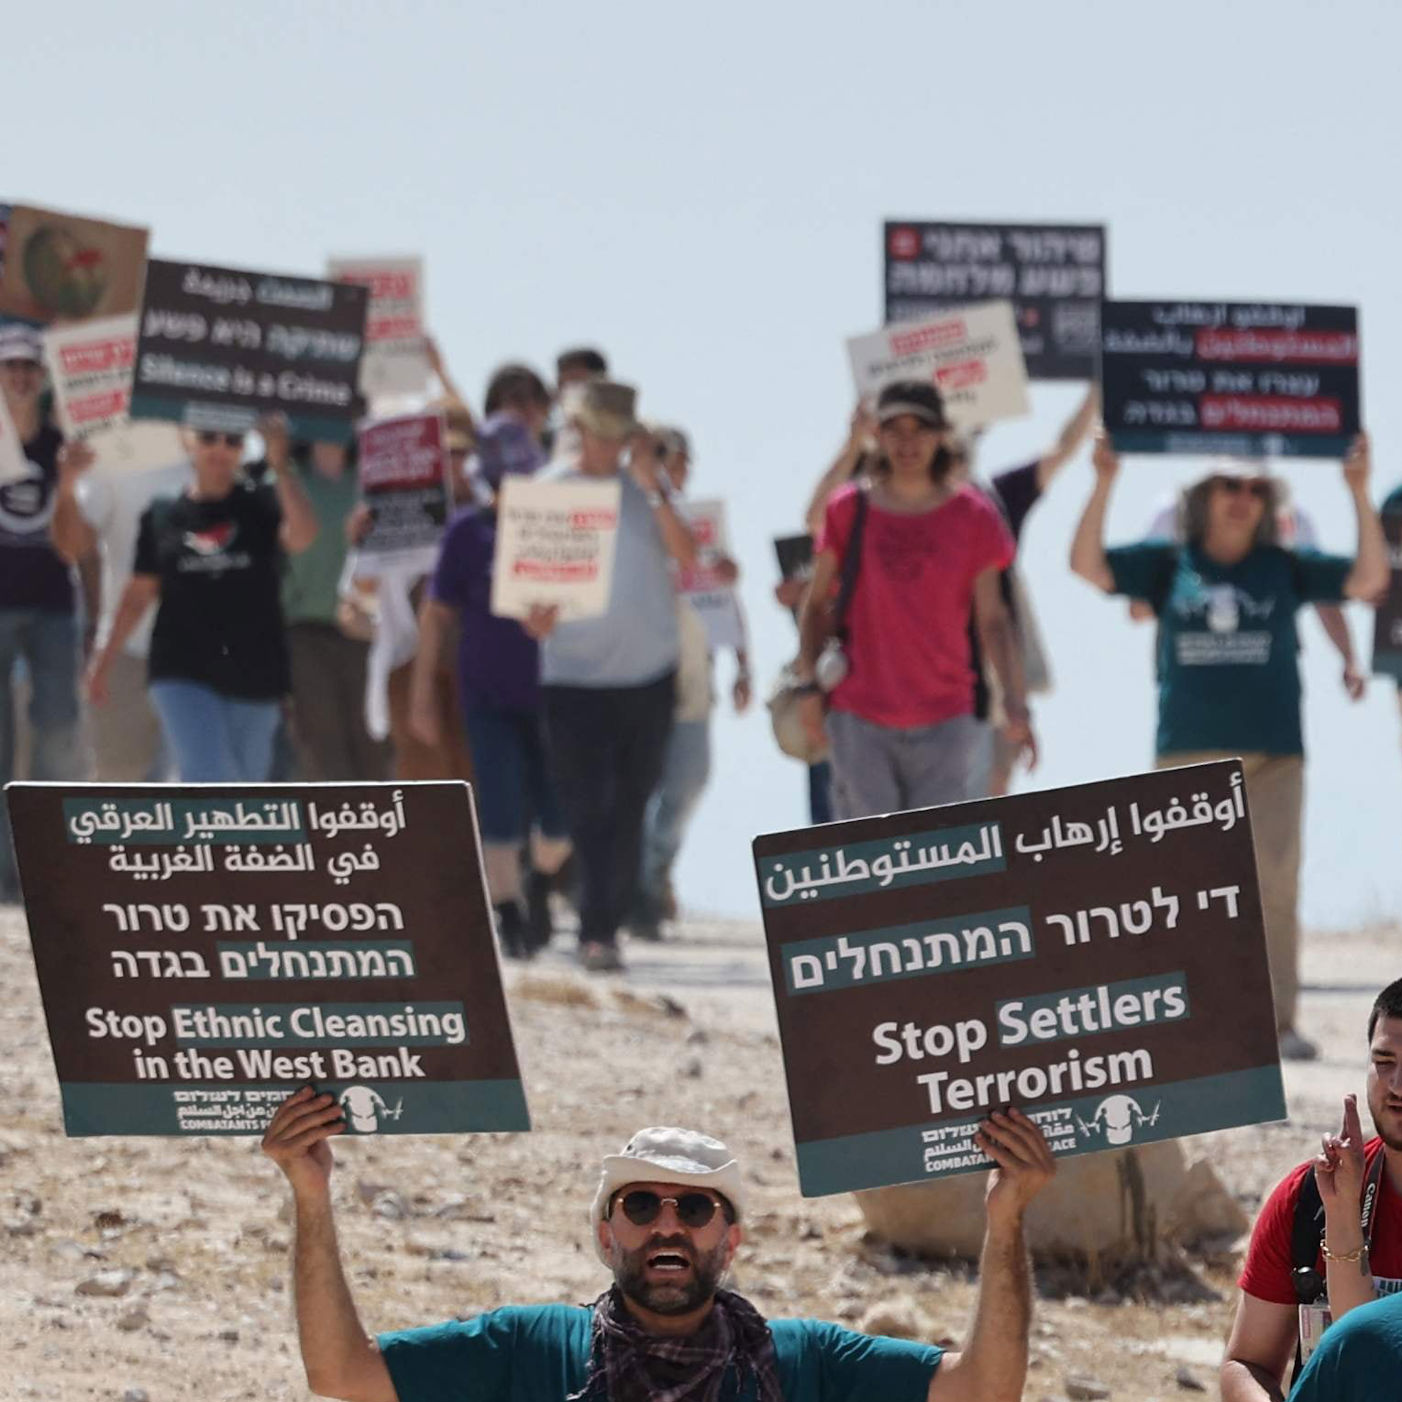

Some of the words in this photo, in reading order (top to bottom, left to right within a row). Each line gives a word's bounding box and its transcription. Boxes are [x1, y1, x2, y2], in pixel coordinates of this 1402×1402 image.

[70, 803, 173, 844] العرقي
[184, 804, 299, 839] التطهير
[309, 790, 405, 838] أوقفوا
[1129, 771, 1245, 843] أوقفوا
[1015, 807, 1121, 860] إرهاب
[109, 845, 213, 881] الغربية
[225, 845, 314, 871] الضفة
[328, 845, 380, 884] في
[765, 823, 1002, 900] المستوطنين
[104, 903, 189, 932] טרור
[205, 904, 259, 932] את
[1046, 886, 1179, 947] לטרור
[1197, 885, 1240, 919] די
[272, 904, 404, 940] הפסיקו
[111, 950, 210, 978] בגדה
[221, 943, 414, 978] המתנחלים
[790, 918, 1031, 990] המתנחלים
[86, 1008, 166, 1044] Stop
[173, 1007, 284, 1039] Ethnic
[291, 1007, 466, 1044] Cleansing
[873, 1017, 987, 1065] Stop
[999, 985, 1186, 1044] Settlers
[133, 1051, 169, 1080] in
[174, 1049, 231, 1079] the
[237, 1051, 328, 1079] West
[332, 1048, 425, 1079] Bank
[918, 1047, 1153, 1113] Terrorism
[1360, 1182, 1376, 1228] Canon
